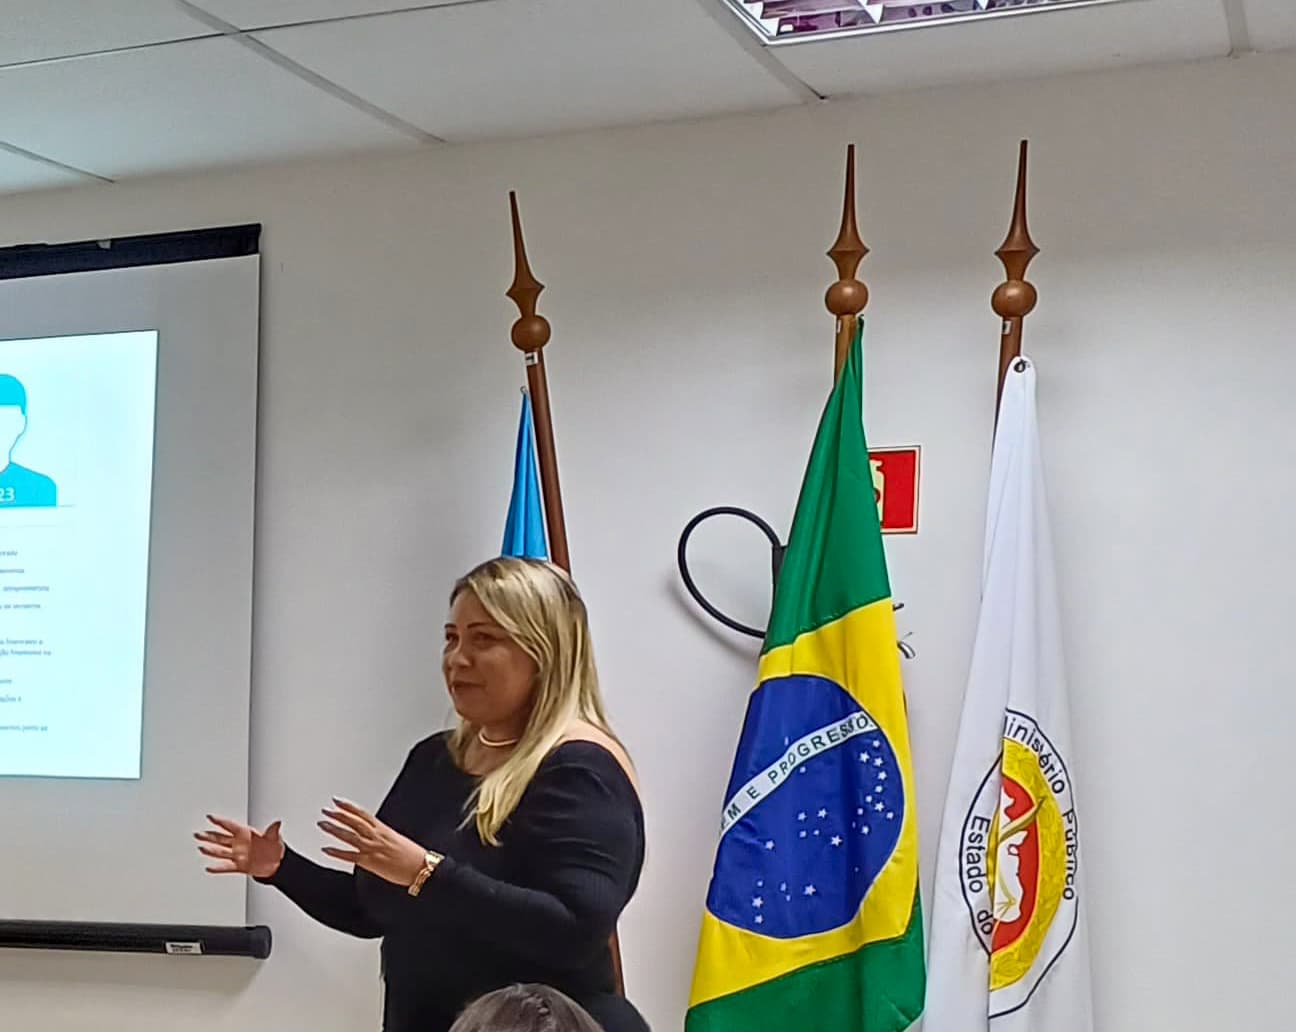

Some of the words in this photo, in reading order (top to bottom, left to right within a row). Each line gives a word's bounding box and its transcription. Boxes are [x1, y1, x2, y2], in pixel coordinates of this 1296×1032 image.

[1003, 715, 1066, 795] inisério
[746, 786, 761, 800] E
[966, 814, 992, 894] Estado
[976, 908, 994, 936] do
